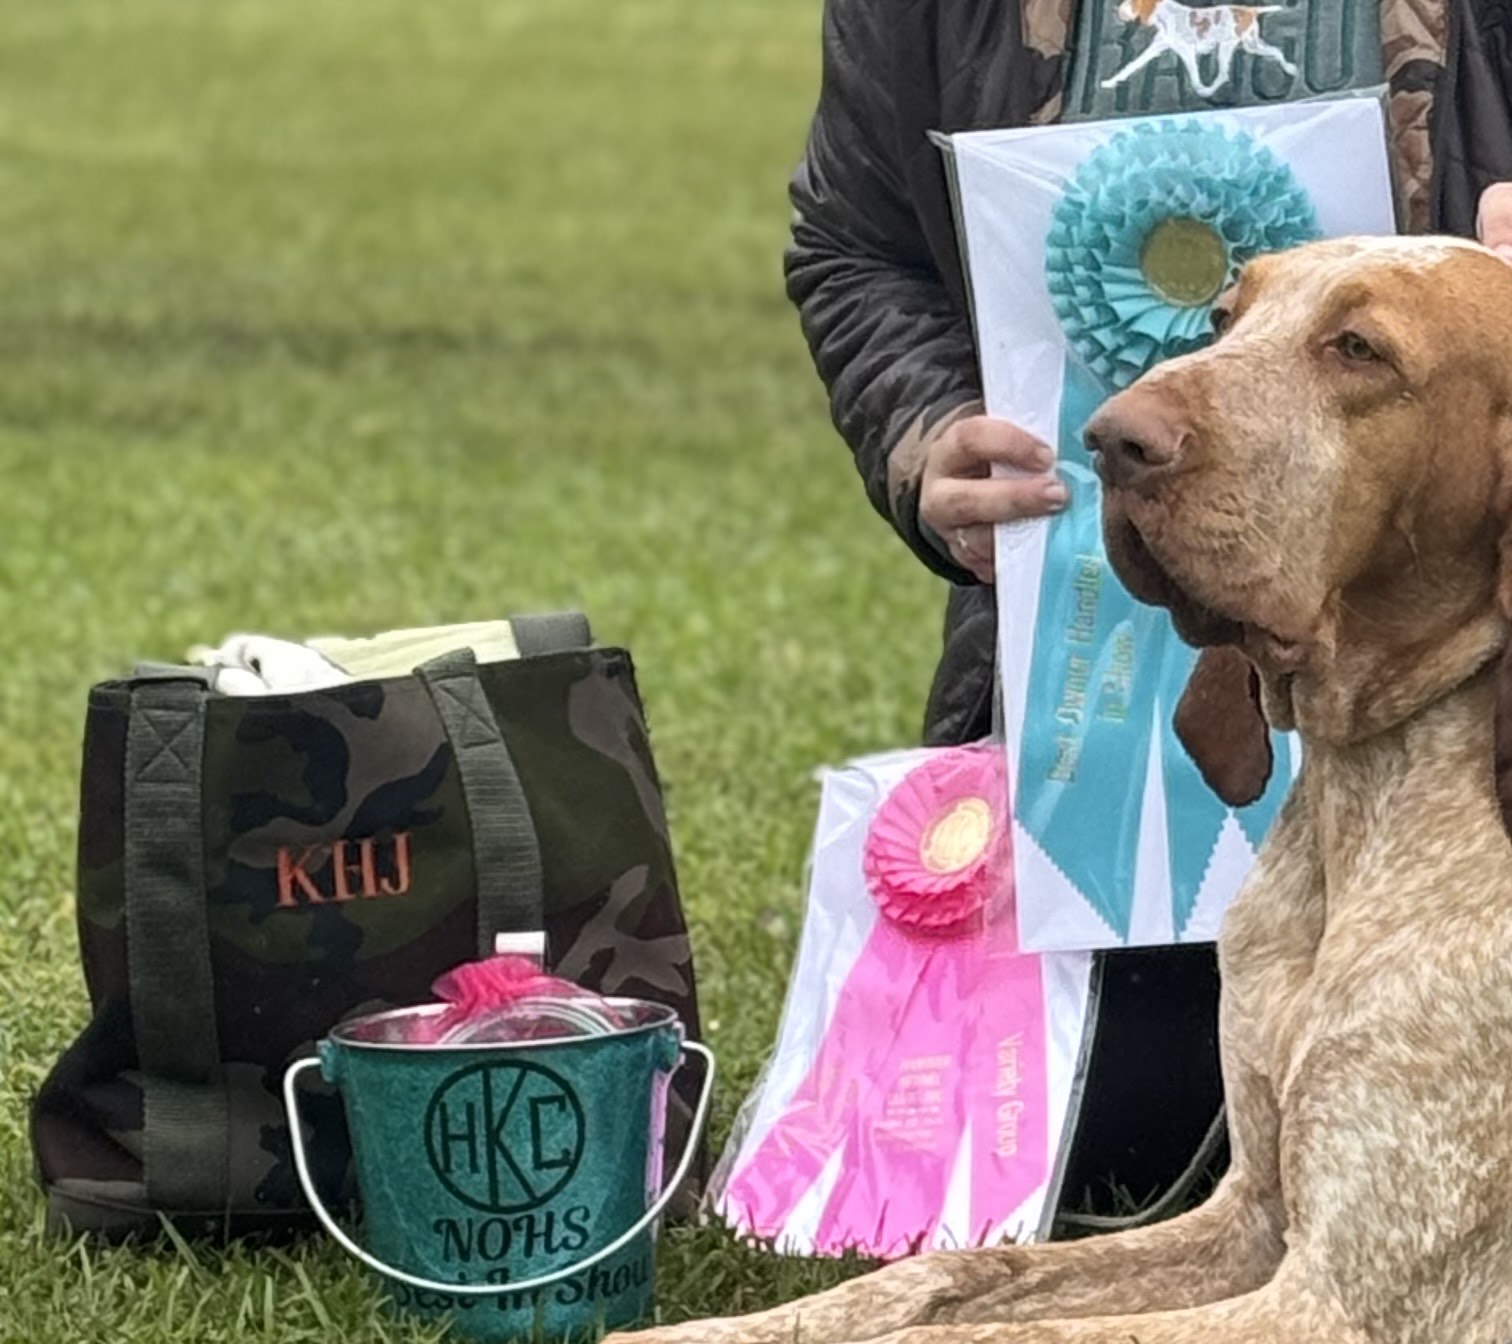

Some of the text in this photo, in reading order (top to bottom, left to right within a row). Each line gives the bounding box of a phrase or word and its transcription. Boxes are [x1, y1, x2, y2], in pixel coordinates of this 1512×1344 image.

[1055, 654, 1091, 724] Owner
[275, 831, 414, 909] KHJ
[438, 1064, 572, 1209] HKC
[994, 1099, 1025, 1157] Group
[431, 1204, 591, 1264] NOHS
